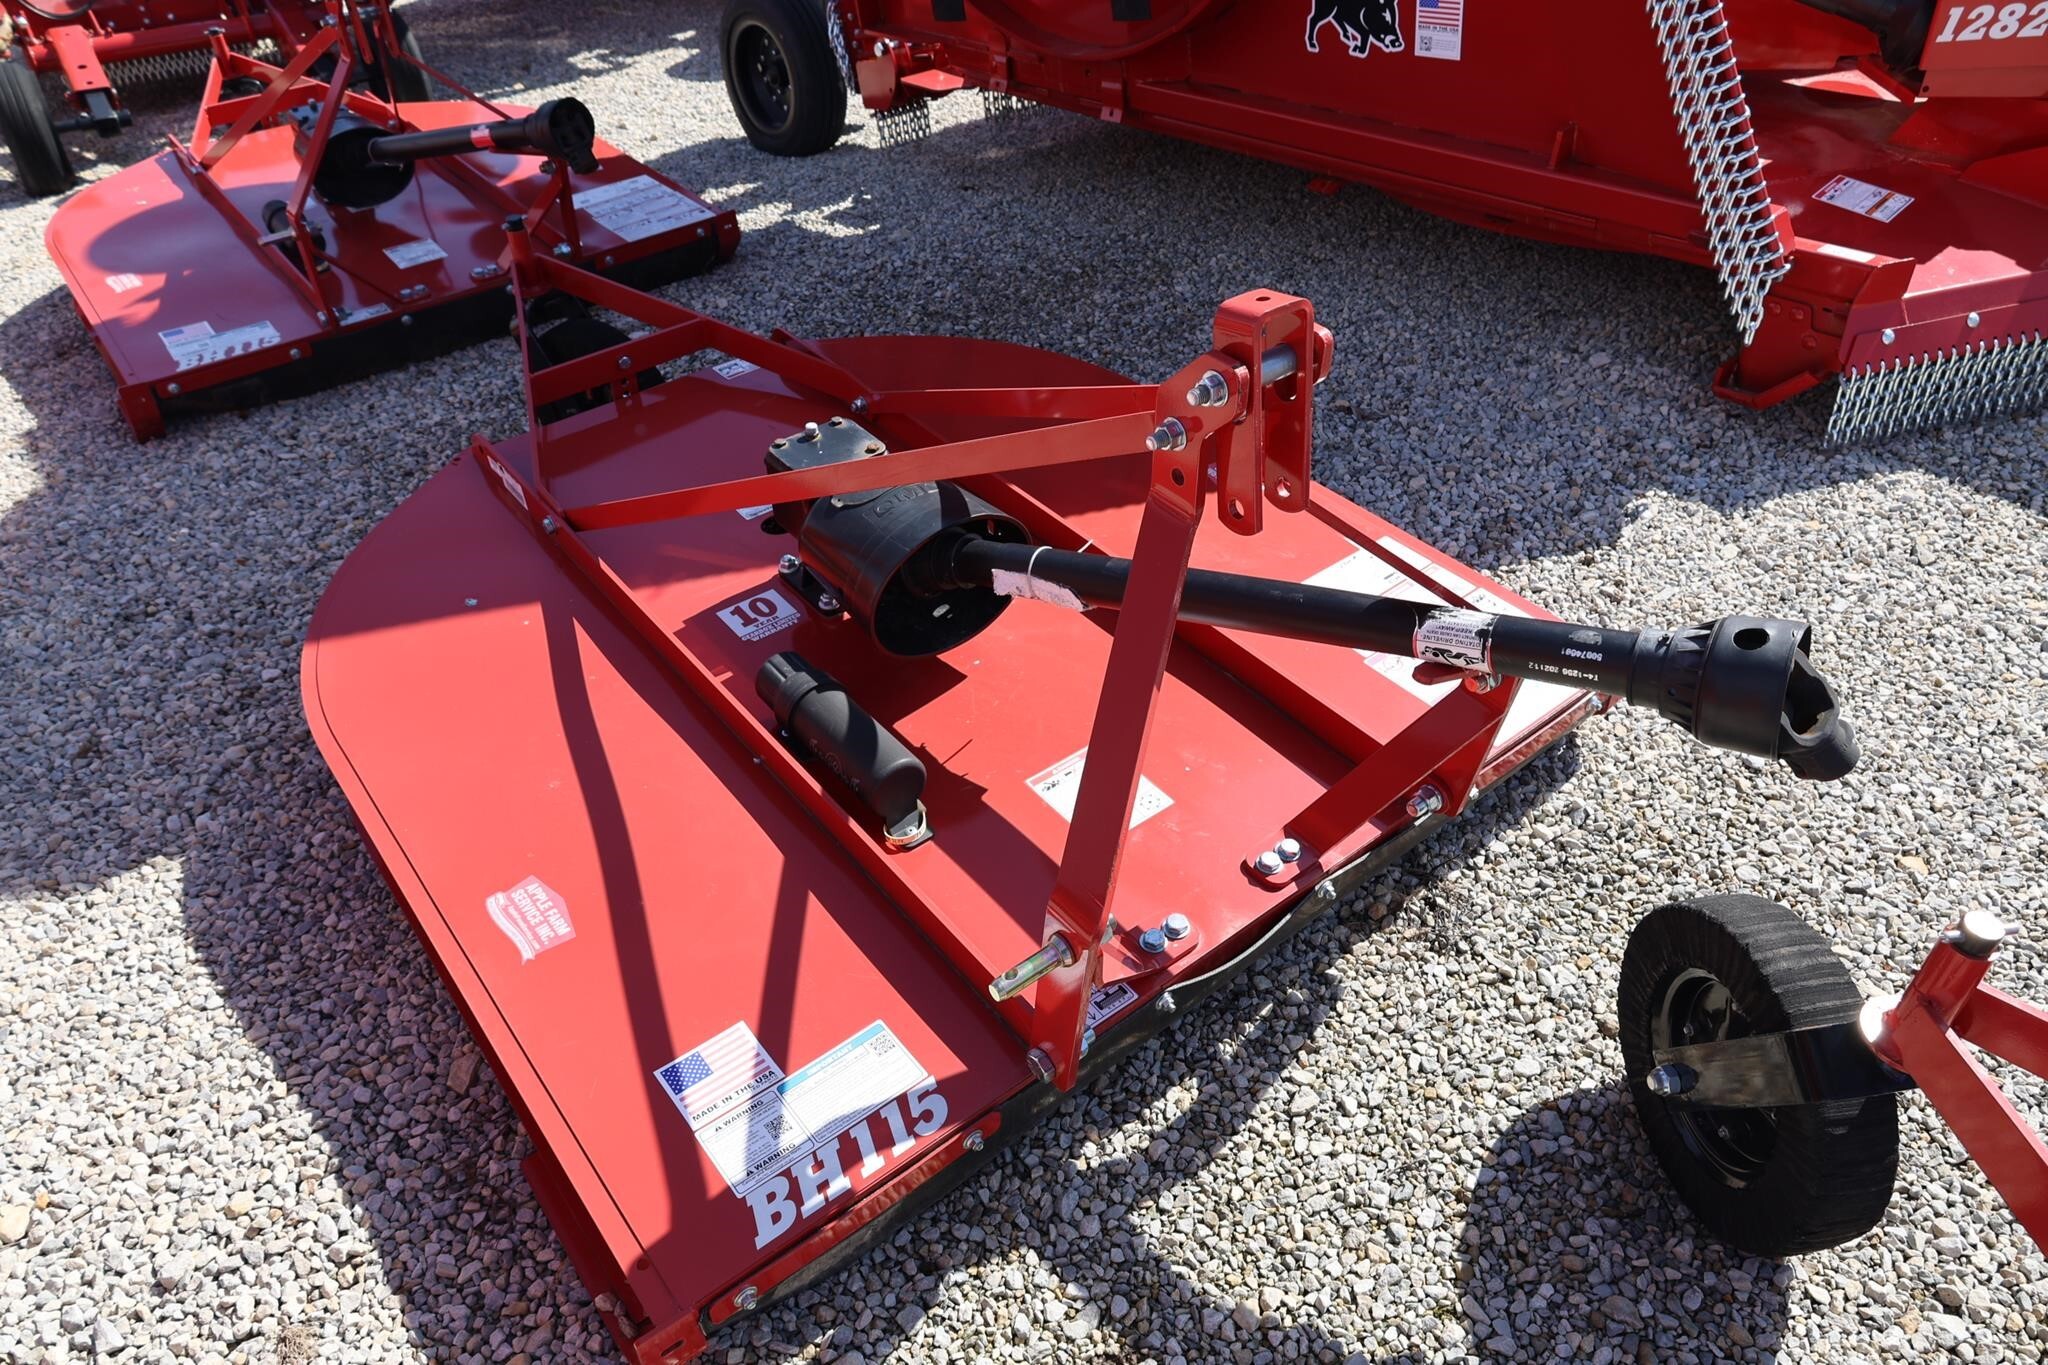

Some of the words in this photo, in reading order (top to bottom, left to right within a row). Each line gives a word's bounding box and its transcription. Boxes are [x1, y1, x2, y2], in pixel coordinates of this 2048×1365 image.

[1936, 2, 2048, 43] 1282
[729, 597, 778, 628] 10
[741, 622, 775, 641] GEARBOX
[774, 612, 801, 628] LIMITED
[753, 615, 780, 628] YEAR
[750, 619, 798, 641] WARRANTY
[511, 888, 544, 926] SERVICE
[535, 922, 555, 945] INC.
[525, 883, 553, 911] APPLE
[544, 908, 571, 936] FARM
[692, 1102, 719, 1122] MADE
[721, 1096, 733, 1105] IN
[735, 1082, 755, 1096] THE
[754, 1069, 776, 1085] USA
[722, 1099, 764, 1127] WARNING
[745, 1075, 949, 1251] BH115
[754, 1142, 797, 1171] WARNING
